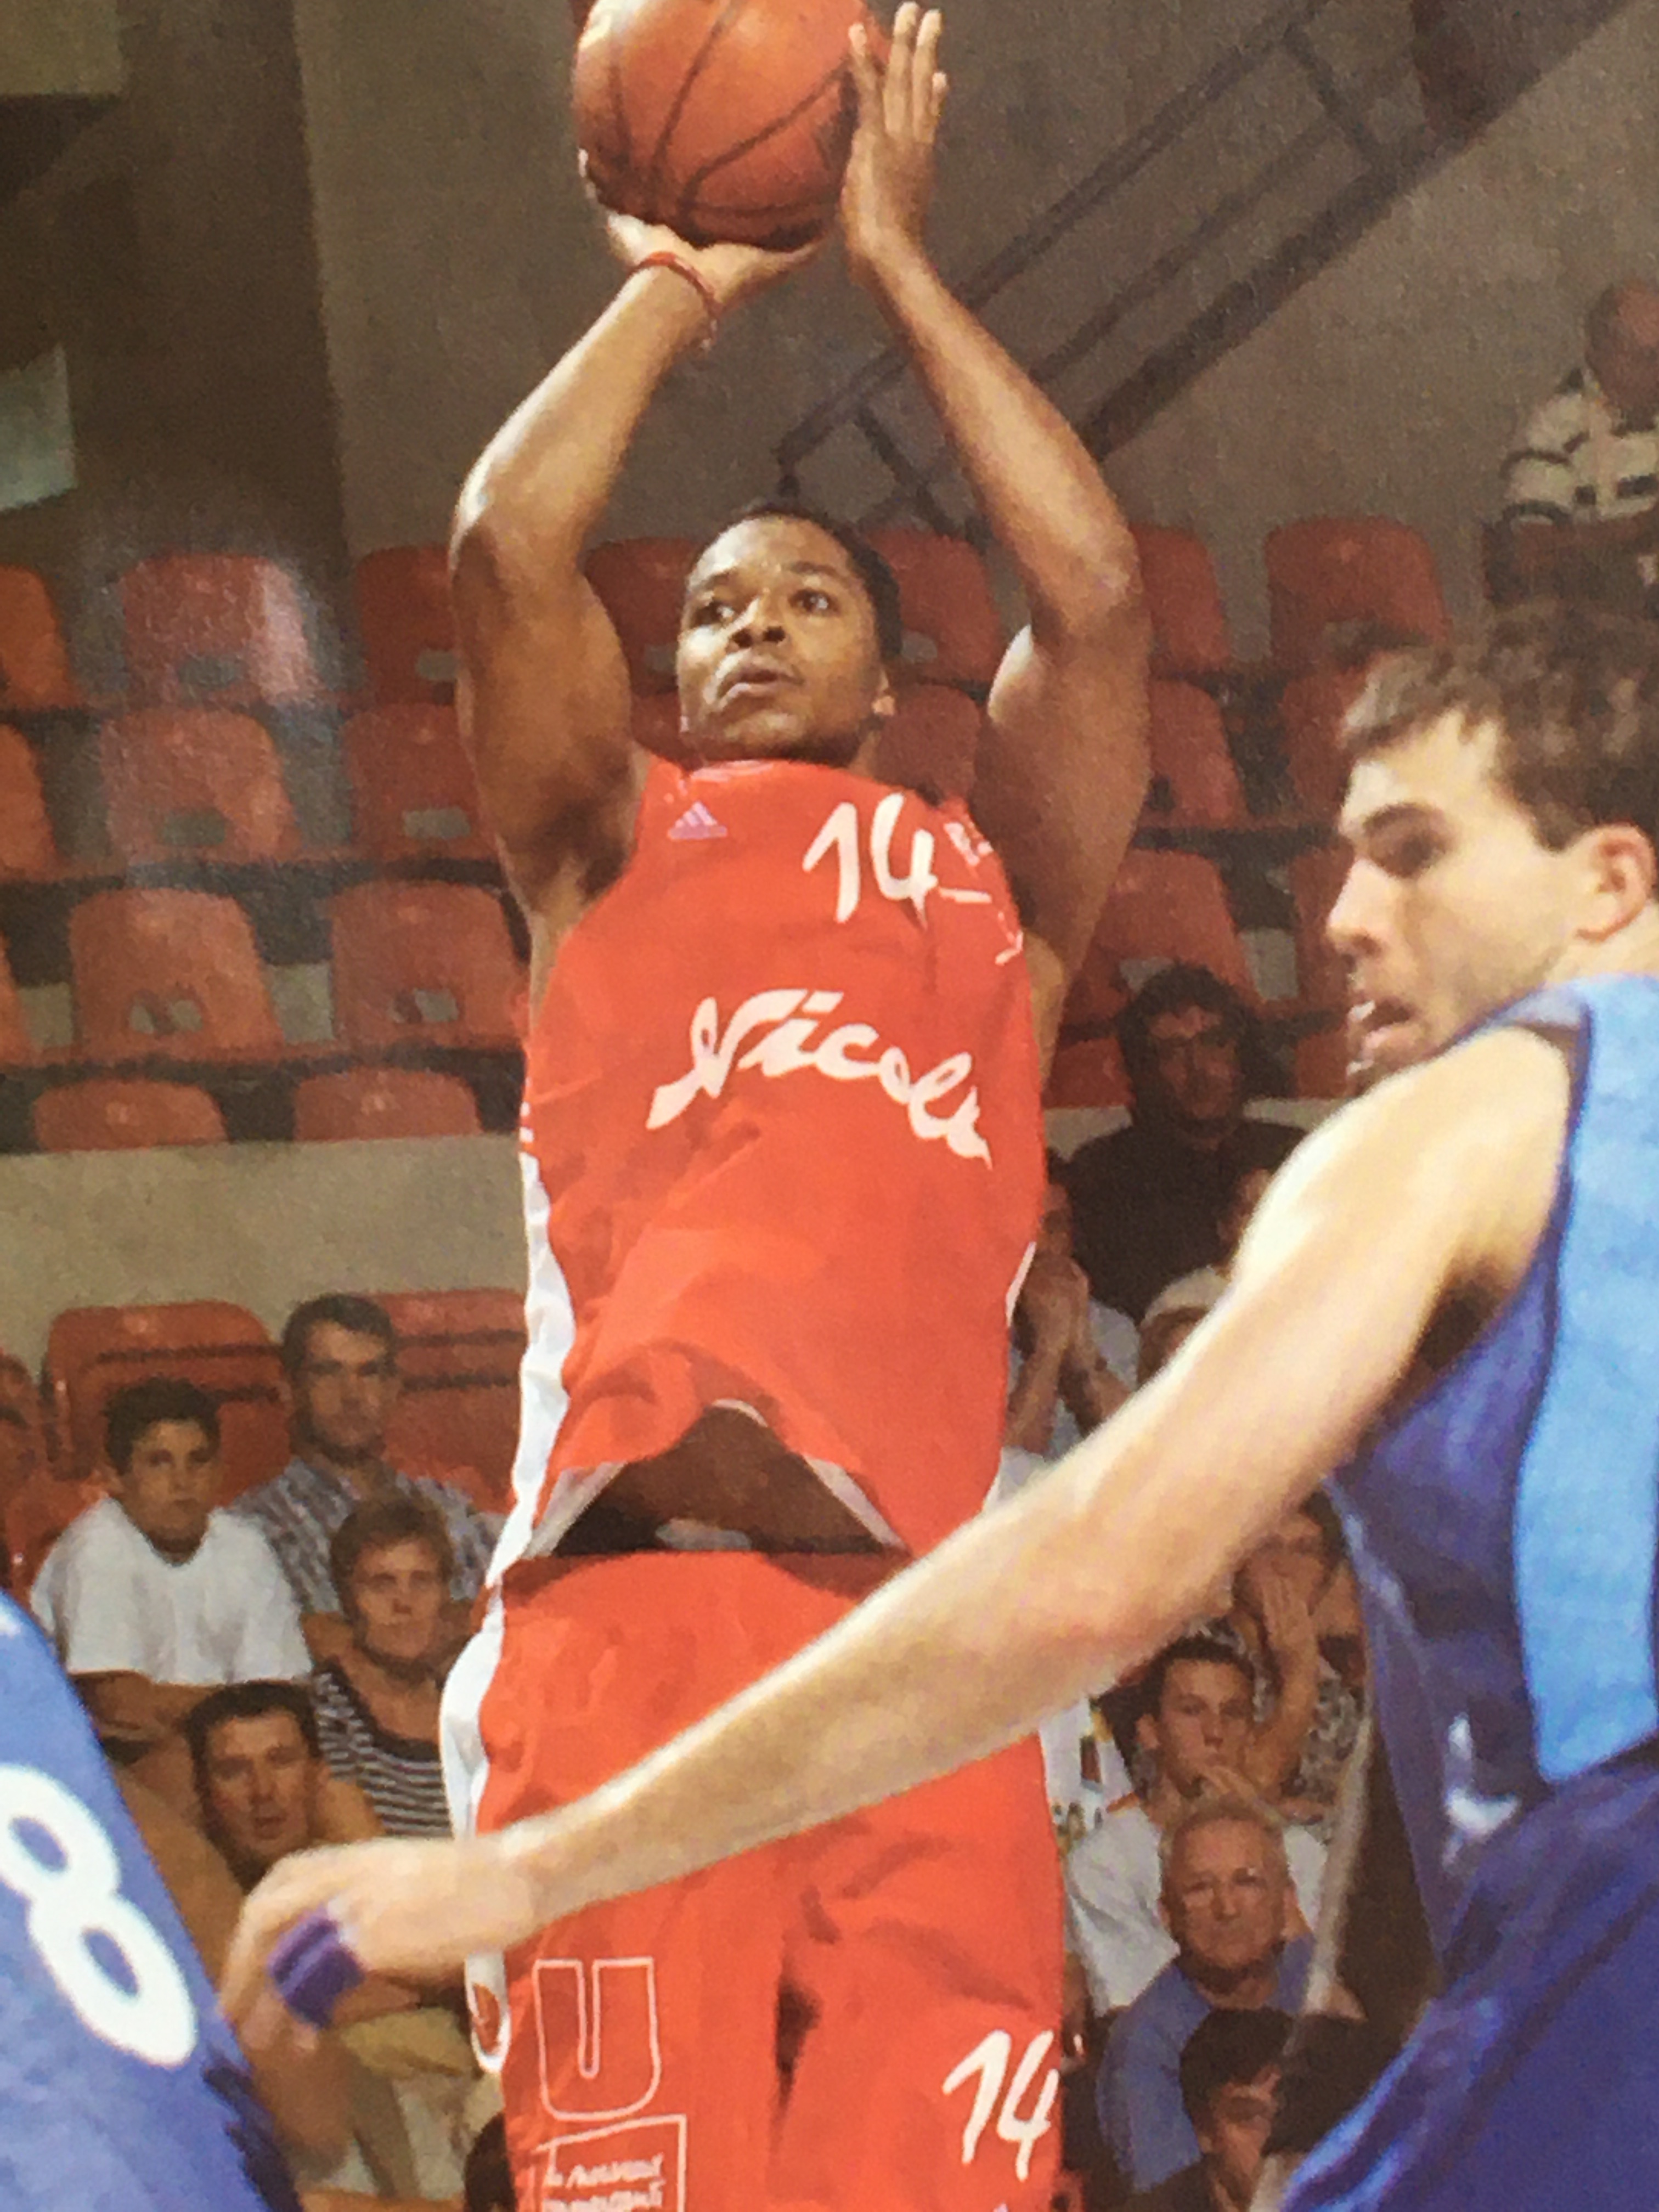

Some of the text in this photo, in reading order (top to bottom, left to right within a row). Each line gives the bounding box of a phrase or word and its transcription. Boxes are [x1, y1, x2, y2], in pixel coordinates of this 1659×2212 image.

[803, 792, 938, 929] 14
[0, 1764, 198, 2072] 8
[943, 2029, 1059, 2181] 14
